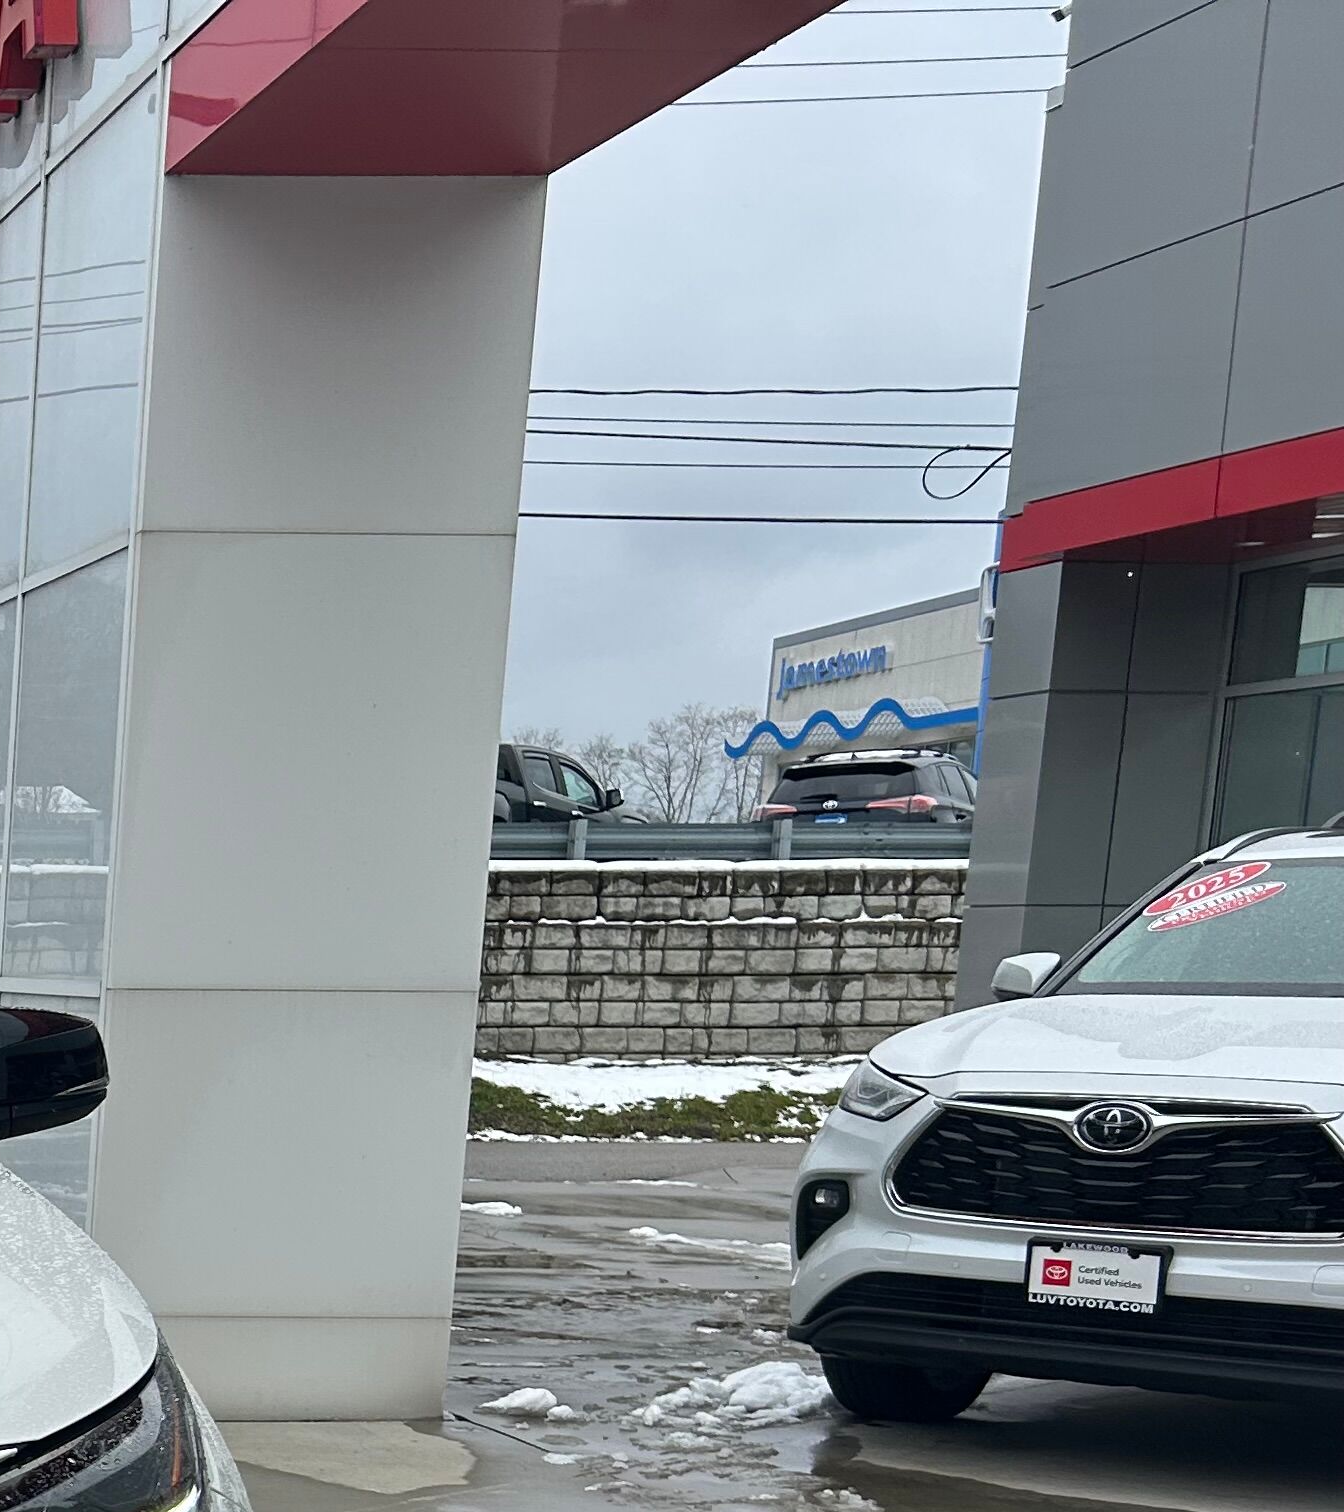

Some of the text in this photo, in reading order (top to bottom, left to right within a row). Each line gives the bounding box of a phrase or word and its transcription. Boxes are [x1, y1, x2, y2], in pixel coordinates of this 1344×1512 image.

[776, 645, 887, 701] Jamestown
[1167, 867, 1246, 909] 2025
[1062, 1241, 1129, 1254] LAKEWOOD
[1078, 1265, 1120, 1277] Certified
[1077, 1276, 1143, 1290] Used Vehicles
[1028, 1292, 1155, 1314] LUVTOYOTA.COM
